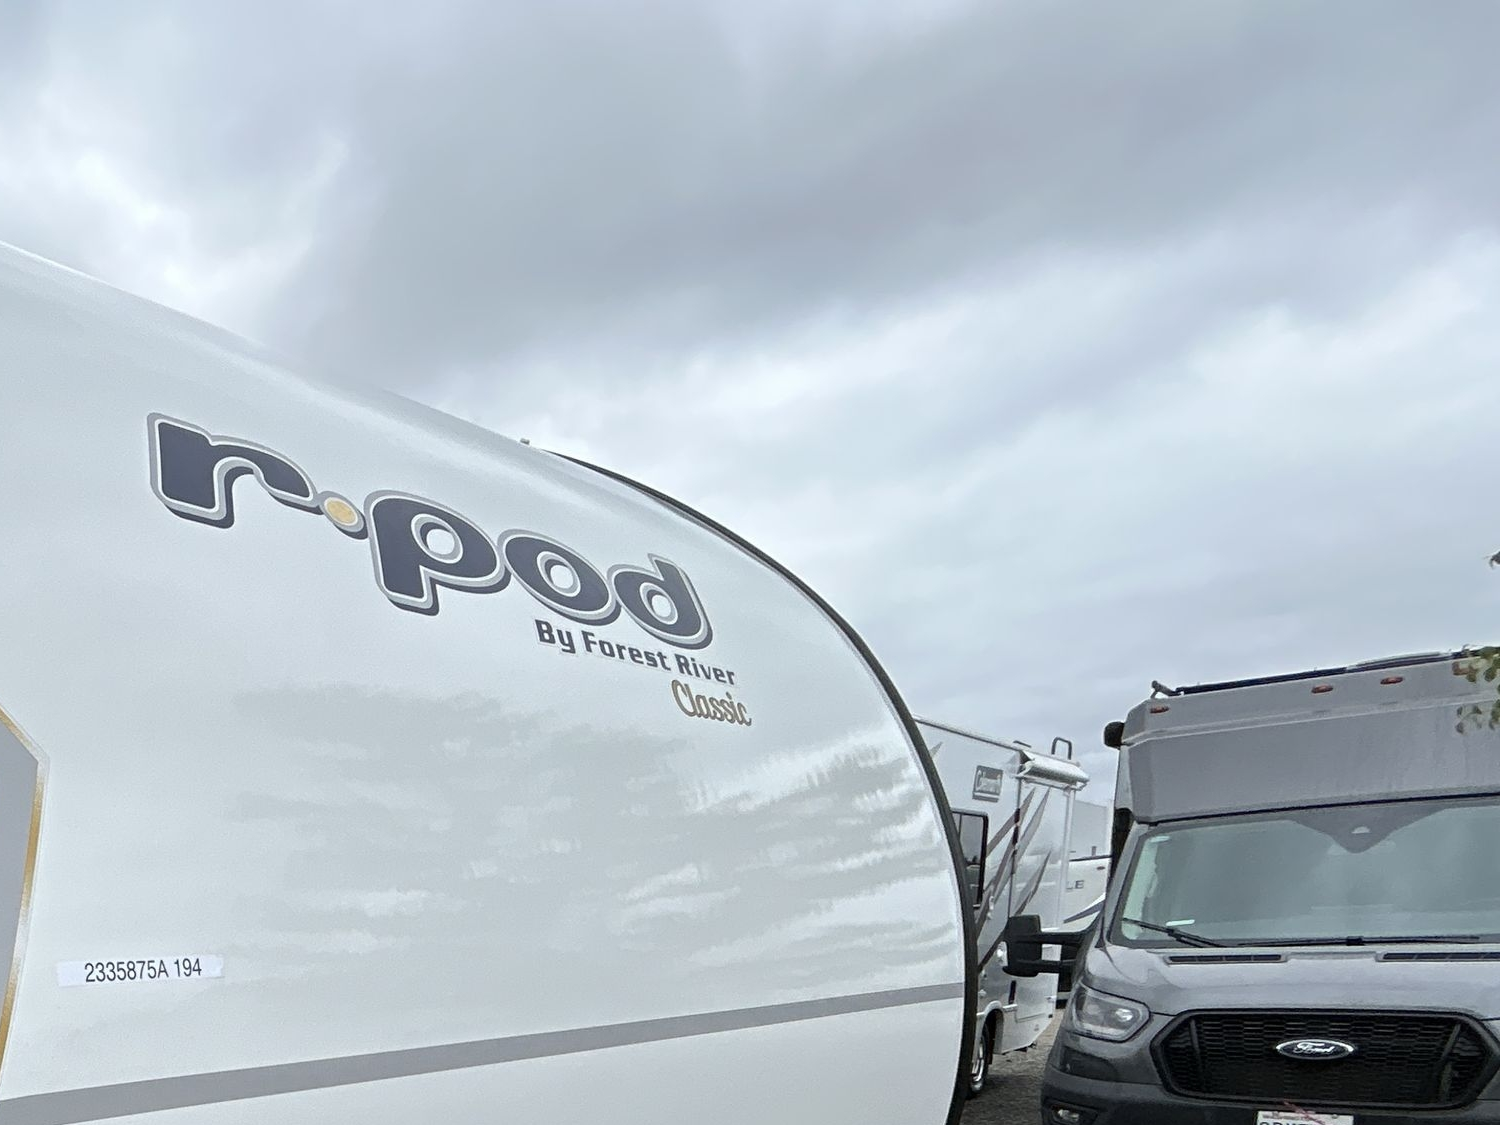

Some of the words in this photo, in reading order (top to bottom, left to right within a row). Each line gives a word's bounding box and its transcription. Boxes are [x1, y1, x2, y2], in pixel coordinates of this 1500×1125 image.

[535, 619, 577, 654] By
[581, 630, 672, 672] Forest
[674, 653, 736, 686] River
[671, 679, 752, 727] Classic
[84, 959, 169, 982] 2335875A
[174, 957, 202, 978] 194
[1293, 1041, 1335, 1055] Ford
